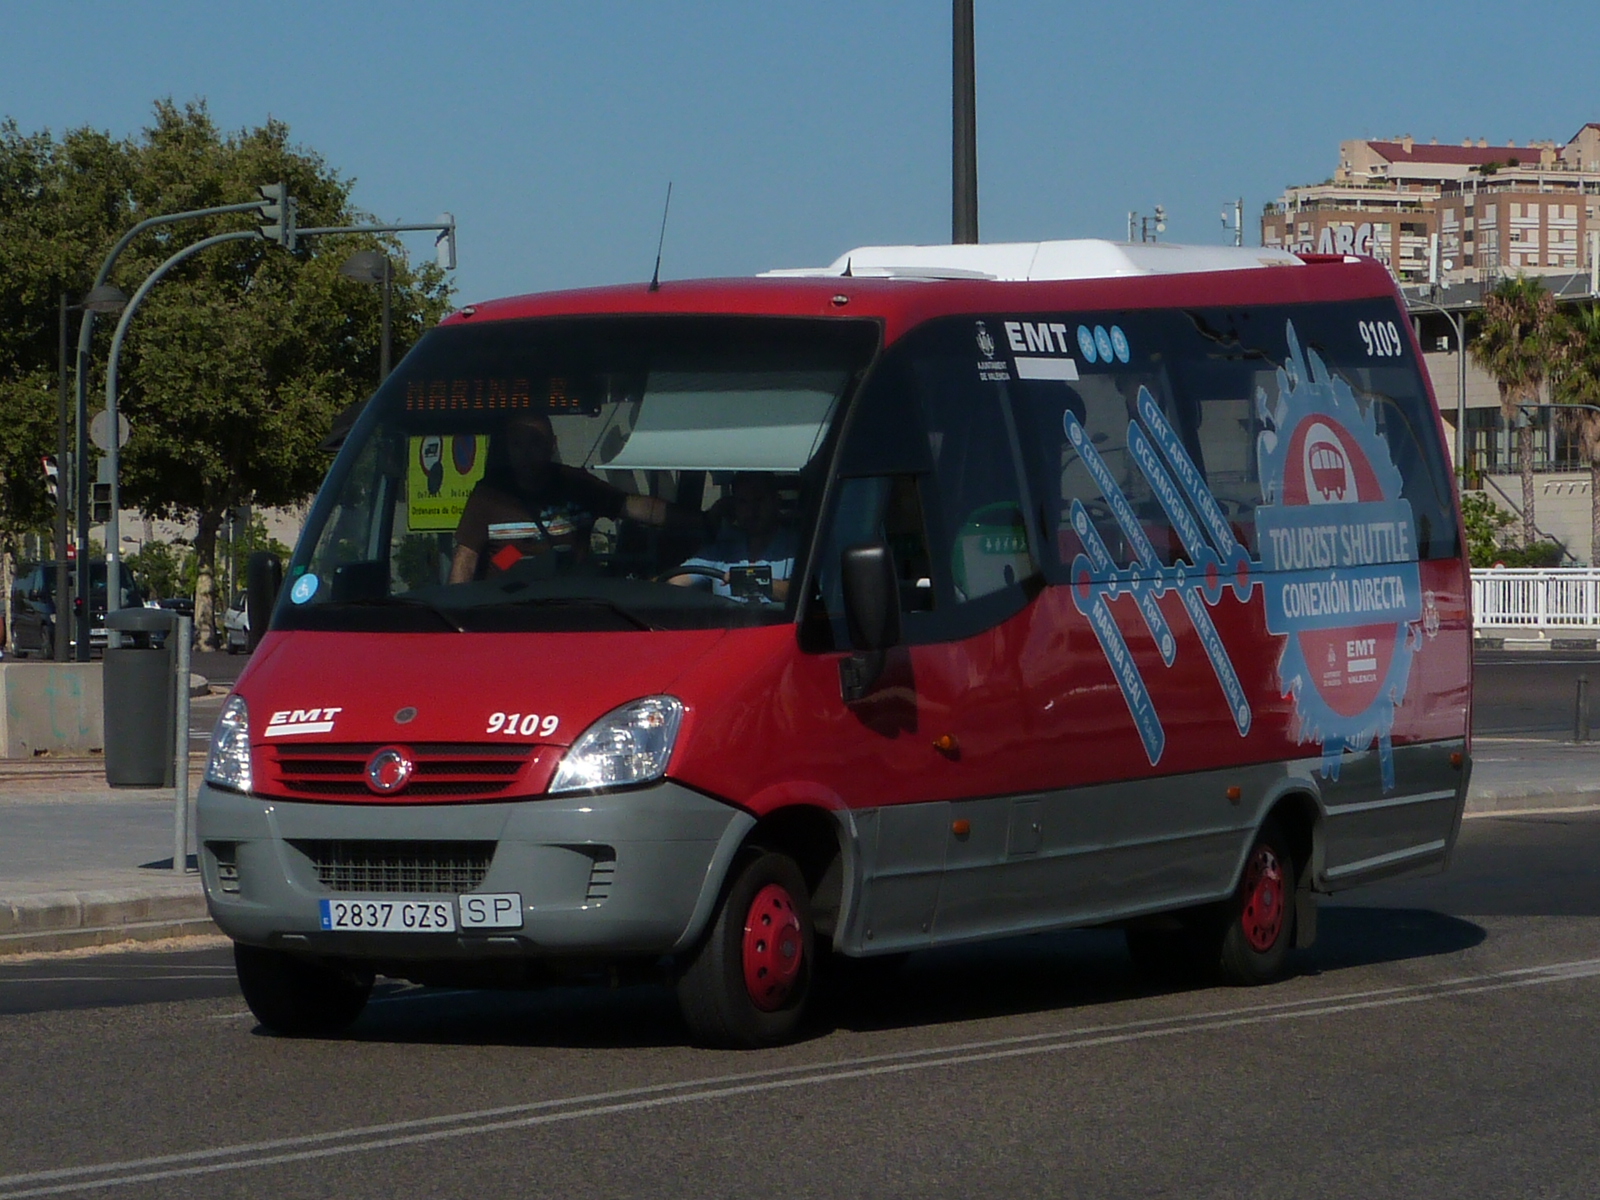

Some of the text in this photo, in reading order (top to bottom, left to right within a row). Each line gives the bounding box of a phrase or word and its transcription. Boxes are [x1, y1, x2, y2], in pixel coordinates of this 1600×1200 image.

[1004, 321, 1067, 353] EMT
[1358, 320, 1402, 357] 9109
[406, 379, 530, 410] MARINA
[1170, 443, 1193, 486] ARTS
[1083, 444, 1152, 569] CENTRE COMERCIAL
[1087, 532, 1109, 570] PORT
[1269, 520, 1410, 571] TOURIST SHUTTLE
[1143, 594, 1163, 633] PORT
[1282, 573, 1406, 619] CONEXIÓN DIRECTA
[1092, 601, 1124, 669] MARINA
[1122, 662, 1142, 710] REAL
[1186, 588, 1239, 710] CENTRE COMERCIAL
[1346, 639, 1376, 658] EMT
[269, 707, 342, 725] EMT
[486, 712, 560, 738] 9109
[335, 904, 449, 928] 2837 GZS
